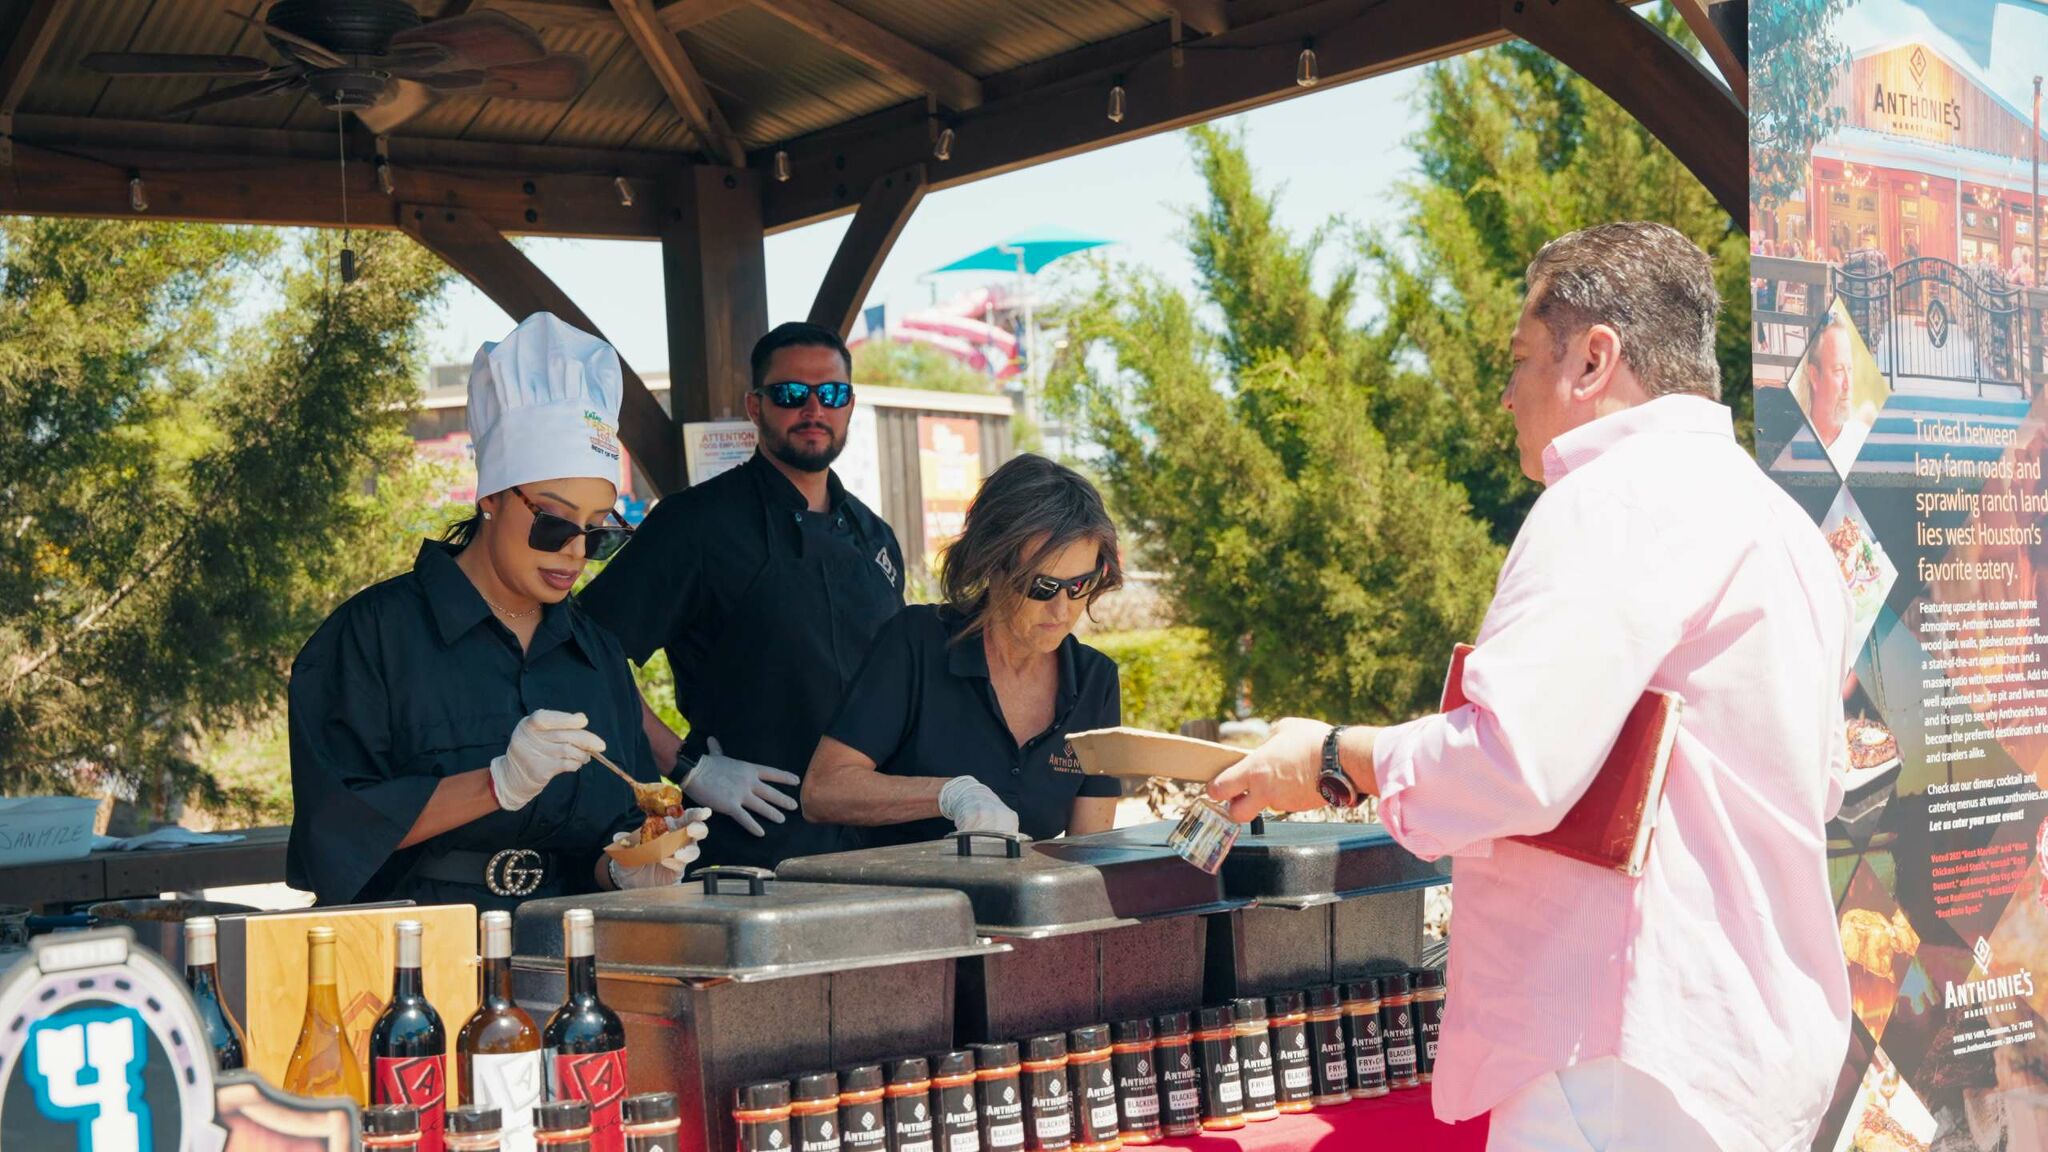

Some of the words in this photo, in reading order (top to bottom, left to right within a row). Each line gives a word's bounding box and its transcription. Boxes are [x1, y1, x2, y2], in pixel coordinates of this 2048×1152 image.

[1873, 83, 1960, 131] ANTHONIE'S
[702, 432, 755, 442] ATTENTION
[1913, 418, 1960, 443] Tucked
[1964, 420, 2017, 446] between
[1915, 451, 1941, 483] lazy
[1943, 452, 1975, 478] farm
[1978, 456, 2013, 479] roads
[2017, 456, 2041, 480] and
[1916, 488, 1980, 519] sprawling
[1982, 489, 2017, 512] ranch
[1917, 521, 1943, 546] lies
[1945, 524, 1976, 545] west
[1978, 522, 2042, 545] Houston's
[1918, 557, 1972, 581] favorite
[1975, 559, 2018, 586] eatery.
[1919, 601, 1952, 616] Featuring
[1952, 601, 1976, 615] upscale
[2000, 600, 2018, 611] down
[2018, 598, 2038, 610] home
[1993, 618, 2015, 629] boasts
[2016, 616, 2040, 627] ancient
[1921, 639, 1942, 651] wood
[1942, 638, 1959, 653] plank
[2004, 634, 2033, 647] concrete
[1921, 660, 1928, 670] a
[1929, 656, 1979, 670] state-of-the-art
[2020, 652, 2034, 663] and
[1923, 677, 1951, 689] massive
[1951, 676, 1968, 690] patio
[1968, 673, 1984, 686] with
[2027, 670, 2041, 681] Add
[1923, 695, 1940, 708] well
[1940, 693, 1972, 709] appointed
[2008, 689, 2022, 700] and
[2022, 687, 2036, 699] live
[1924, 714, 1940, 727] and
[1940, 712, 1950, 725] it's
[1951, 714, 1964, 727] easy
[1965, 713, 1973, 723] to
[1973, 712, 1985, 722] see
[1985, 709, 1998, 724] why
[1999, 706, 2034, 720] Anthonie's
[2034, 705, 2047, 717] has
[1925, 732, 1952, 746] become
[1953, 731, 1964, 742] the
[1964, 728, 1995, 745] preferred
[1995, 725, 2034, 738] destination
[2034, 723, 2042, 735] of
[1926, 751, 1940, 764] and
[1941, 749, 1968, 763] travelers
[1968, 747, 1986, 759] alike.
[1927, 782, 1949, 795] Check
[1950, 782, 1961, 793] out
[1961, 781, 1973, 791] our
[1973, 778, 1996, 790] dinner,
[1996, 772, 2023, 787] cocktail
[2023, 771, 2038, 784] and
[1928, 801, 1957, 814] catering
[1957, 797, 1979, 810] menus
[1979, 796, 1987, 807] at
[1929, 821, 1942, 832] Let
[1943, 820, 1952, 831] us
[1952, 818, 1969, 830] cater
[1968, 816, 1985, 830] your
[1986, 813, 2002, 825] next
[2002, 809, 2025, 822] event!
[0, 823, 84, 850] SANITIZE
[1945, 967, 2034, 1009] ANTHONIE'S
[1964, 1005, 1993, 1019] MARKET
[1995, 1001, 2017, 1012] GRILL
